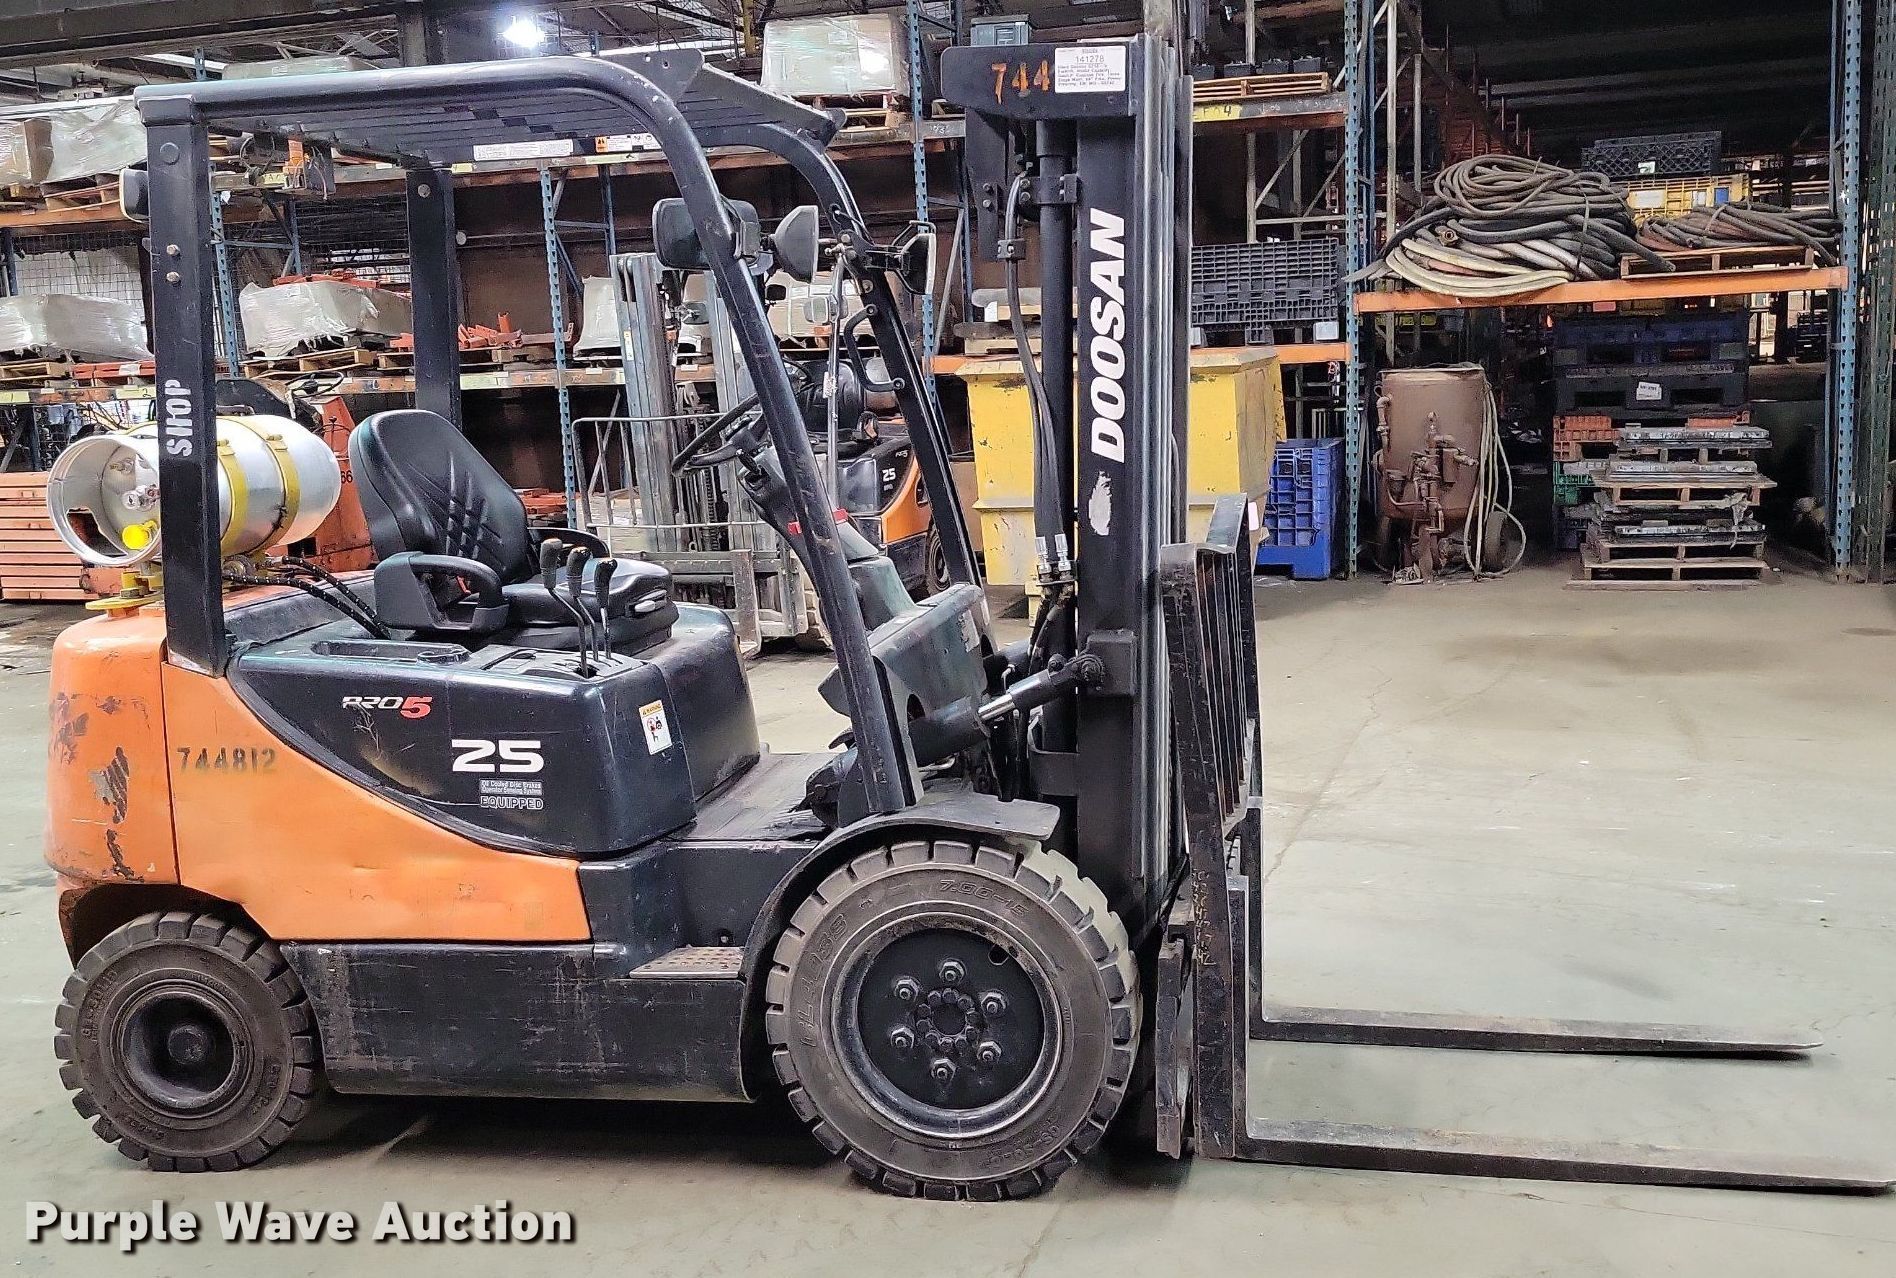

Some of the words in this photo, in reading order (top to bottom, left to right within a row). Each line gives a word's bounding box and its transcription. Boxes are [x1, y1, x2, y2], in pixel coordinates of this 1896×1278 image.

[991, 60, 1050, 104] 744
[1090, 207, 1126, 463] DOOSAN
[164, 379, 193, 457] SHOP
[881, 467, 897, 482] 25
[177, 746, 276, 772] 744812
[451, 739, 545, 773] 25
[480, 795, 544, 810] EQUIPPED
